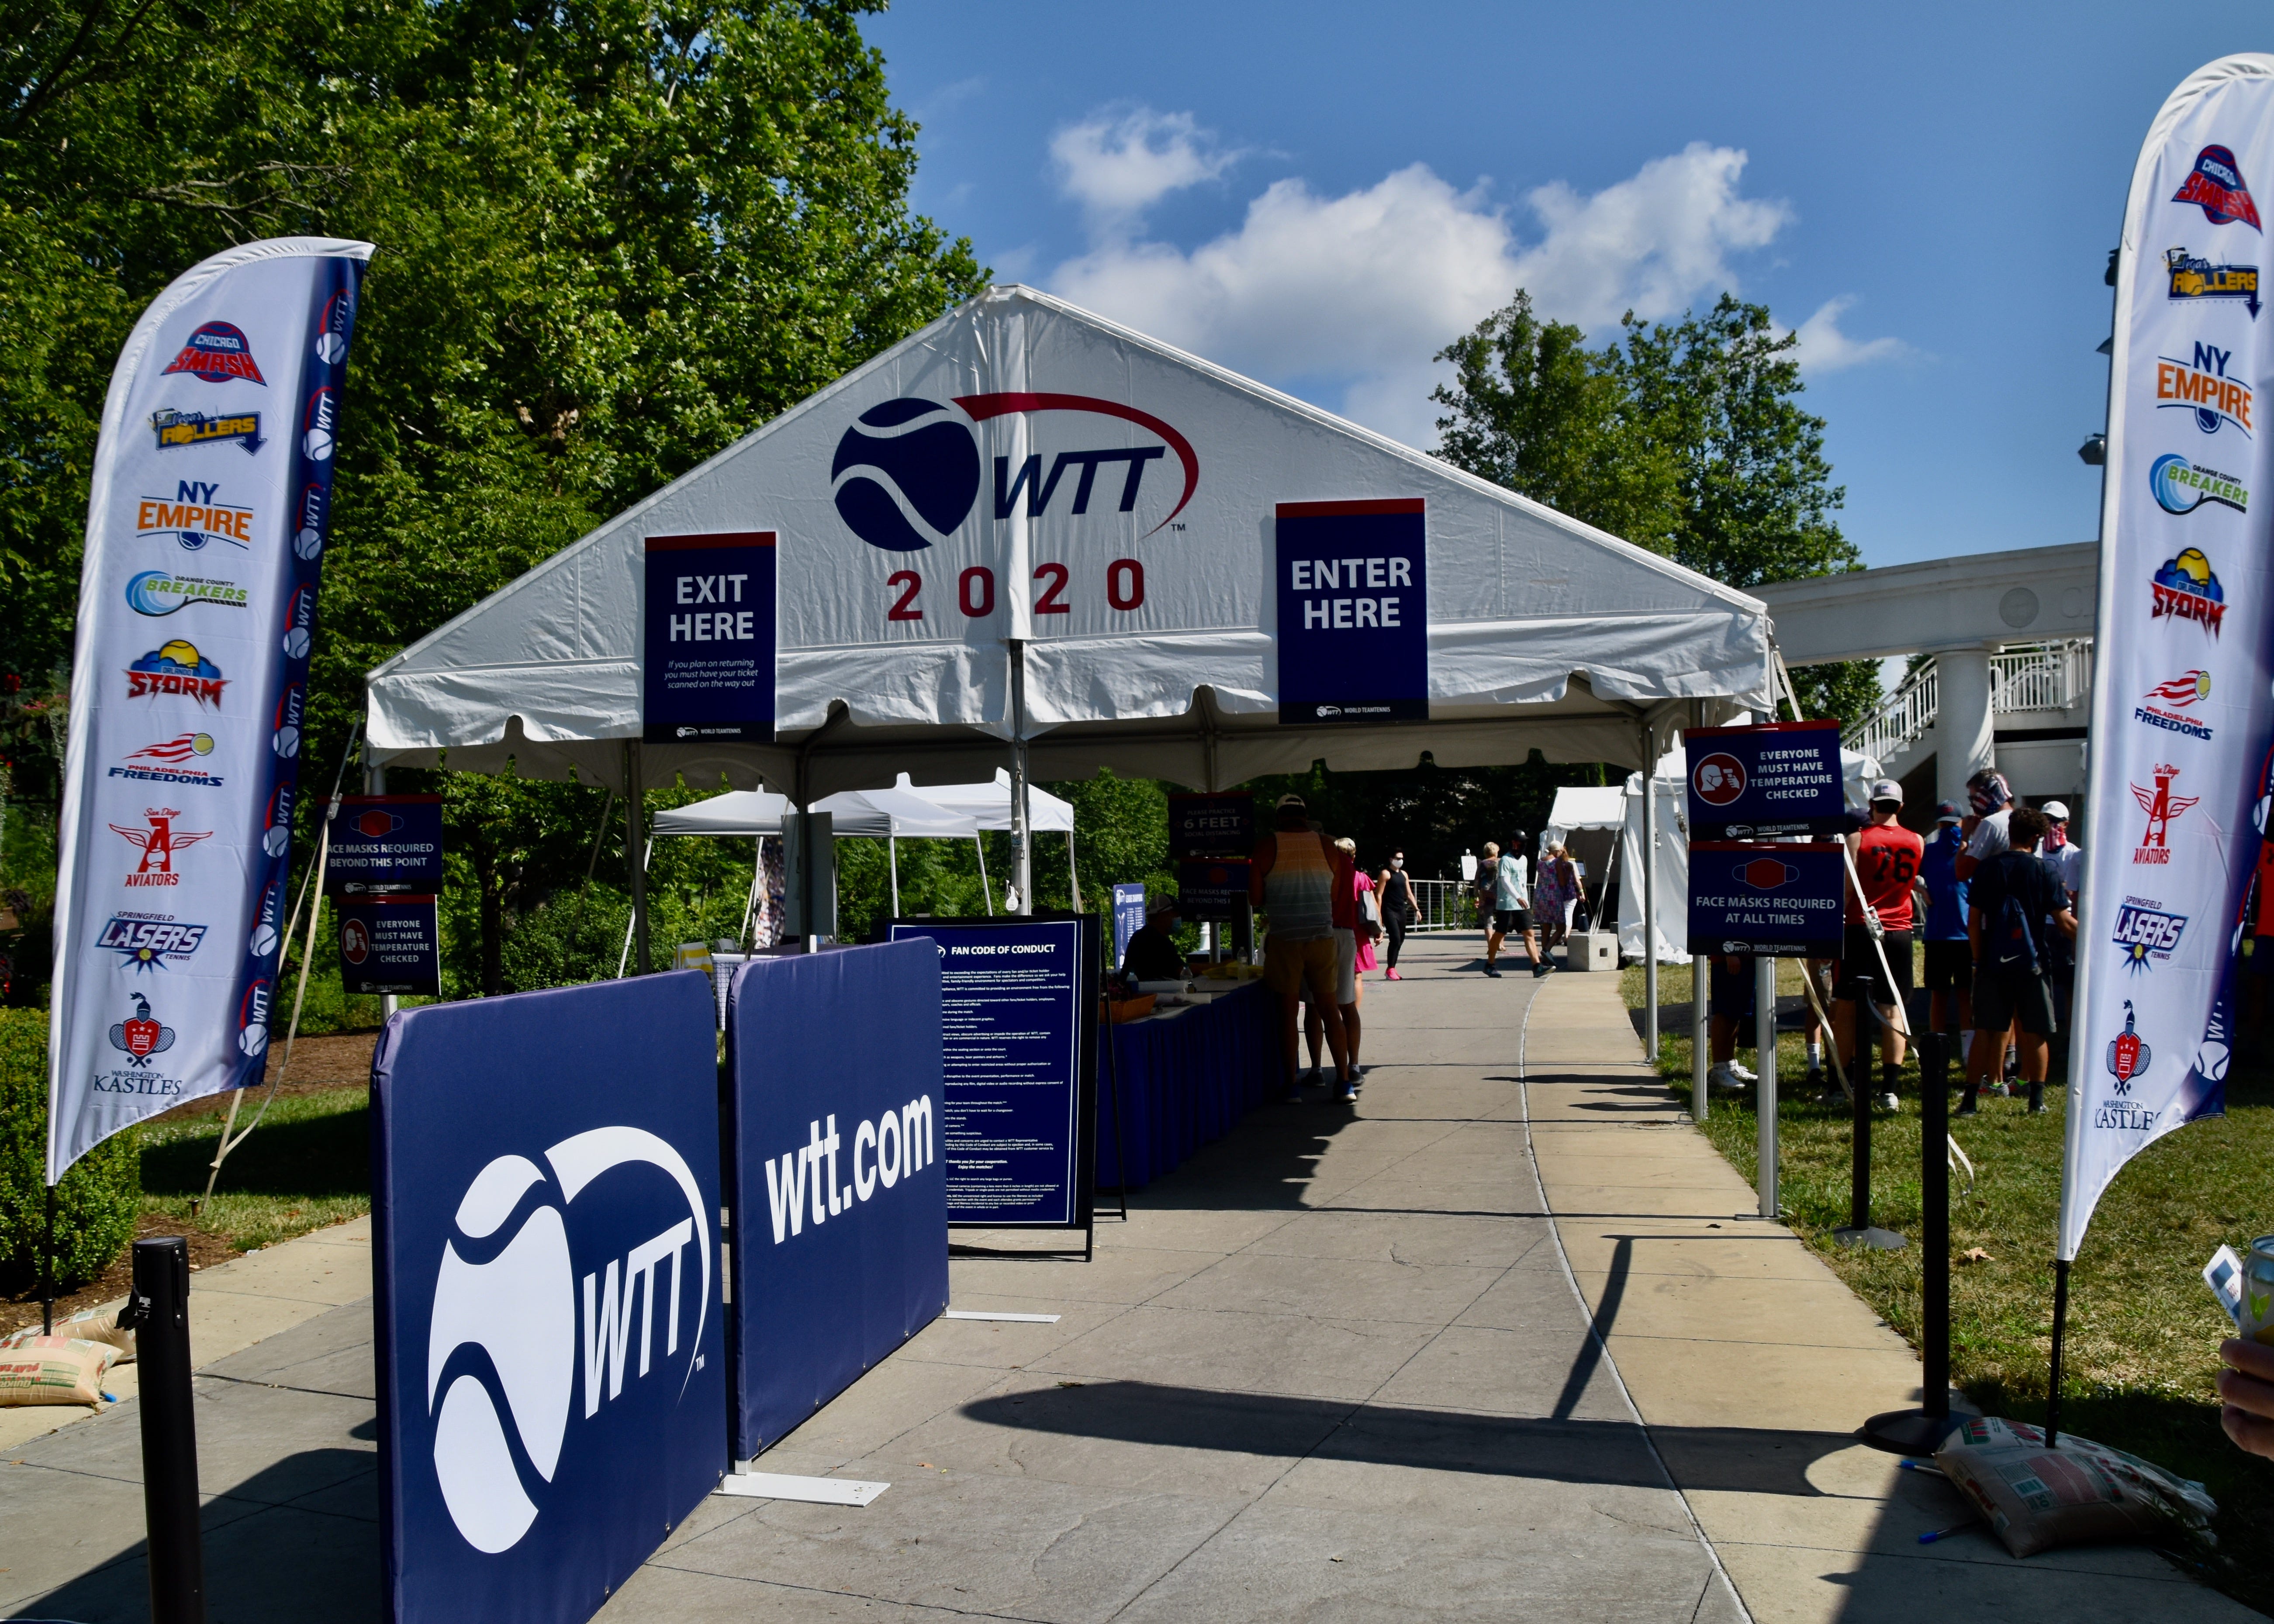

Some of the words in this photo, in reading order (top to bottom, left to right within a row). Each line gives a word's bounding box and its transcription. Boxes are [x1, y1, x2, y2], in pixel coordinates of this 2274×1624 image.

[2176, 171, 2262, 230] SMASH
[333, 295, 348, 331] WTT
[195, 334, 240, 349] CHICAGO
[164, 347, 266, 383] SMASH
[2194, 340, 2232, 377] NY
[2157, 362, 2253, 430] EMPIRE
[317, 393, 335, 430] WTT
[161, 417, 256, 444] ROLLERS
[994, 445, 1166, 520] WTT
[2167, 465, 2249, 505] BREAKERS
[2192, 464, 2218, 478] ORANGE
[2219, 472, 2242, 486] COUNTY
[177, 479, 220, 505] NY
[306, 490, 321, 527] WTT
[138, 501, 253, 542] EMPIRE
[206, 579, 235, 587] COUNTY
[1292, 557, 1412, 590] ENTER
[145, 579, 248, 601] BREAKERS
[677, 574, 748, 604] EXIT
[2177, 581, 2203, 596] ORLANDO
[298, 590, 311, 625] WTT
[1304, 597, 1401, 630] HERE
[2150, 582, 2228, 645] STORM
[670, 611, 754, 642] HERE
[162, 666, 192, 676] ORLANDO
[689, 660, 706, 669] plan
[719, 659, 754, 668] returning
[719, 671, 736, 679] your
[737, 669, 758, 677] ticket
[124, 670, 230, 713] STORM
[667, 680, 698, 689] scanned
[287, 688, 301, 724] WTT
[2146, 706, 2203, 727] PHILADELPHIA
[2134, 707, 2213, 741] FREEDOMS
[1760, 748, 1819, 760] EVERYONE
[108, 767, 224, 787] FREEDOMS
[128, 765, 208, 777] PHILADELPHIA
[1758, 763, 1790, 773] MUST
[1793, 762, 1823, 772] HAVE
[1750, 774, 1832, 787] TEMPERATURE
[1766, 789, 1818, 800] CHECKED
[144, 808, 159, 817] San
[161, 808, 181, 819] Diego
[277, 788, 290, 824] WTT
[1184, 819, 1194, 829] 6
[1199, 817, 1240, 828] FEET
[327, 844, 344, 853] ACE
[346, 844, 379, 853] MASKS
[381, 843, 434, 853] REQUIRED
[2132, 848, 2170, 865] AVIATORS
[330, 858, 368, 867] BEYOND
[370, 858, 392, 867] THIS
[395, 857, 427, 866] POINT
[1871, 845, 1916, 883] 76
[124, 873, 180, 887] AVIATORS
[262, 887, 276, 922] WTT
[1696, 896, 1725, 907] FACE
[1728, 897, 1770, 908] MASKS
[1773, 898, 1836, 910] REQUIRED
[2125, 895, 2162, 910] SPRINGFIELD
[116, 911, 174, 921] SPRINGFIELD
[1725, 913, 1740, 923] AT
[1743, 914, 1765, 924] ALL
[1767, 914, 1804, 924] TIMES
[99, 921, 204, 952] LASERS
[2113, 908, 2184, 949] LASERS
[951, 946, 969, 955] FAN
[971, 946, 996, 955] CODE
[997, 945, 1010, 954] OF
[1011, 944, 1056, 954] CONDUCT
[2150, 951, 2170, 960] TENNIS
[253, 986, 268, 1022] WTT
[93, 1075, 182, 1095] KASTLES
[111, 1070, 164, 1079] WASHINGTON
[2103, 1100, 2143, 1110] WASHINGTON
[765, 1093, 934, 1245] wtt.com
[583, 1216, 694, 1421] WTT
[695, 1354, 705, 1370] TM
